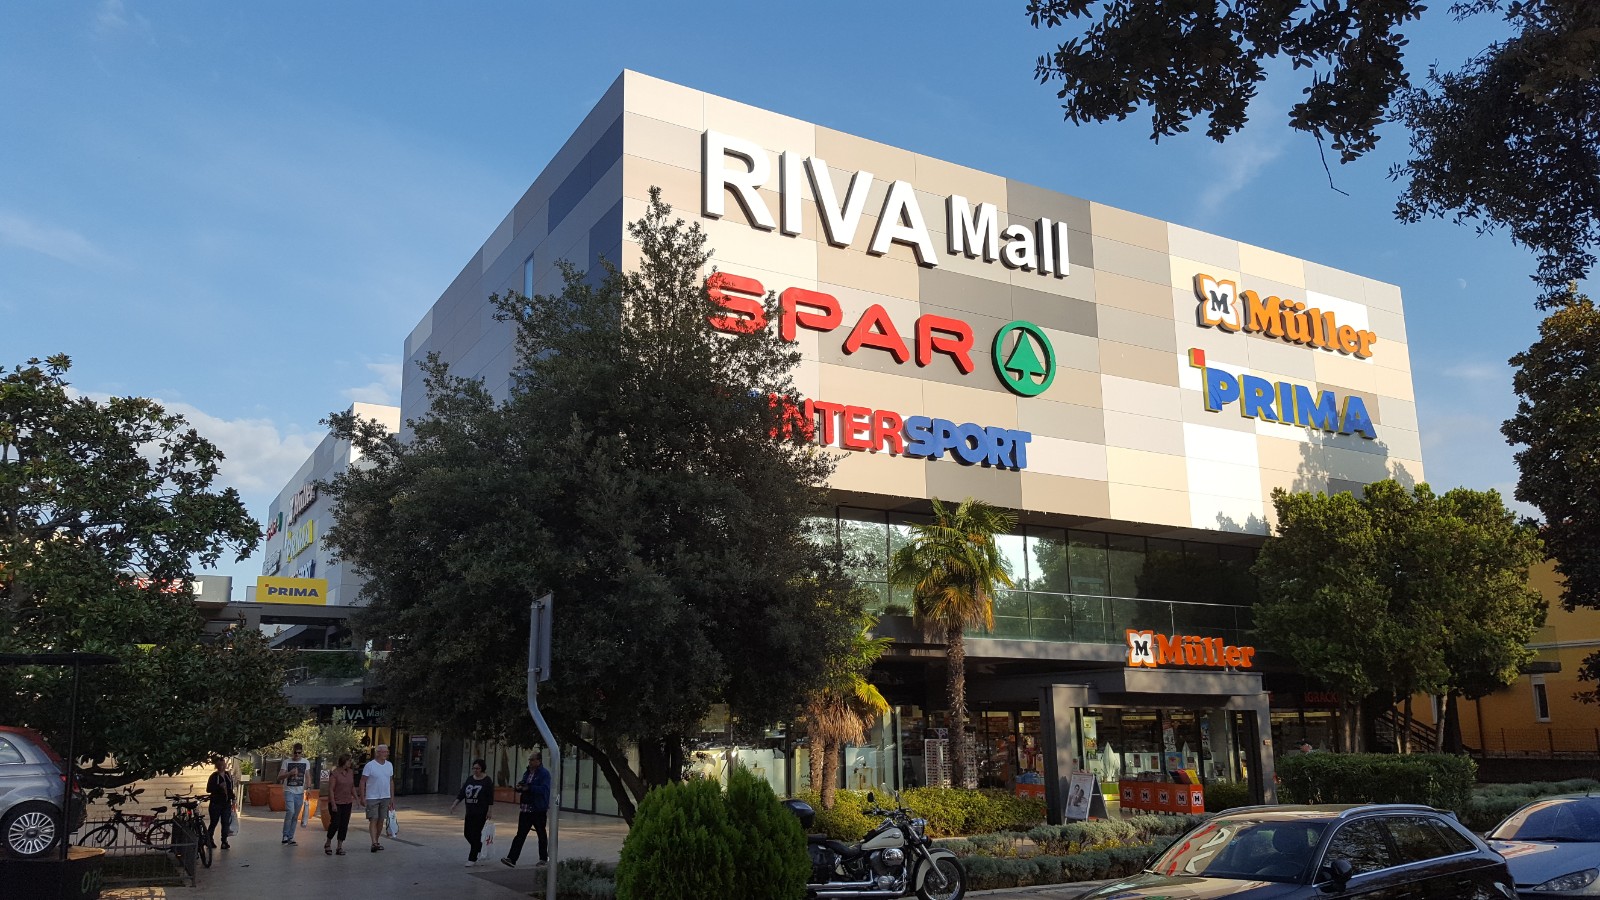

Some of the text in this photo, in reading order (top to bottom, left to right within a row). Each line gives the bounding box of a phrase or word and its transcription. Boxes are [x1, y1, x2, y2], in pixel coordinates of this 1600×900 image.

[701, 128, 1070, 278] RIVA Mall
[707, 271, 974, 375] SPAR
[1209, 289, 1376, 359] M Müller
[1203, 367, 1377, 439] PRIMA
[267, 586, 319, 597] PRIMA
[1134, 634, 1255, 668] M Müller
